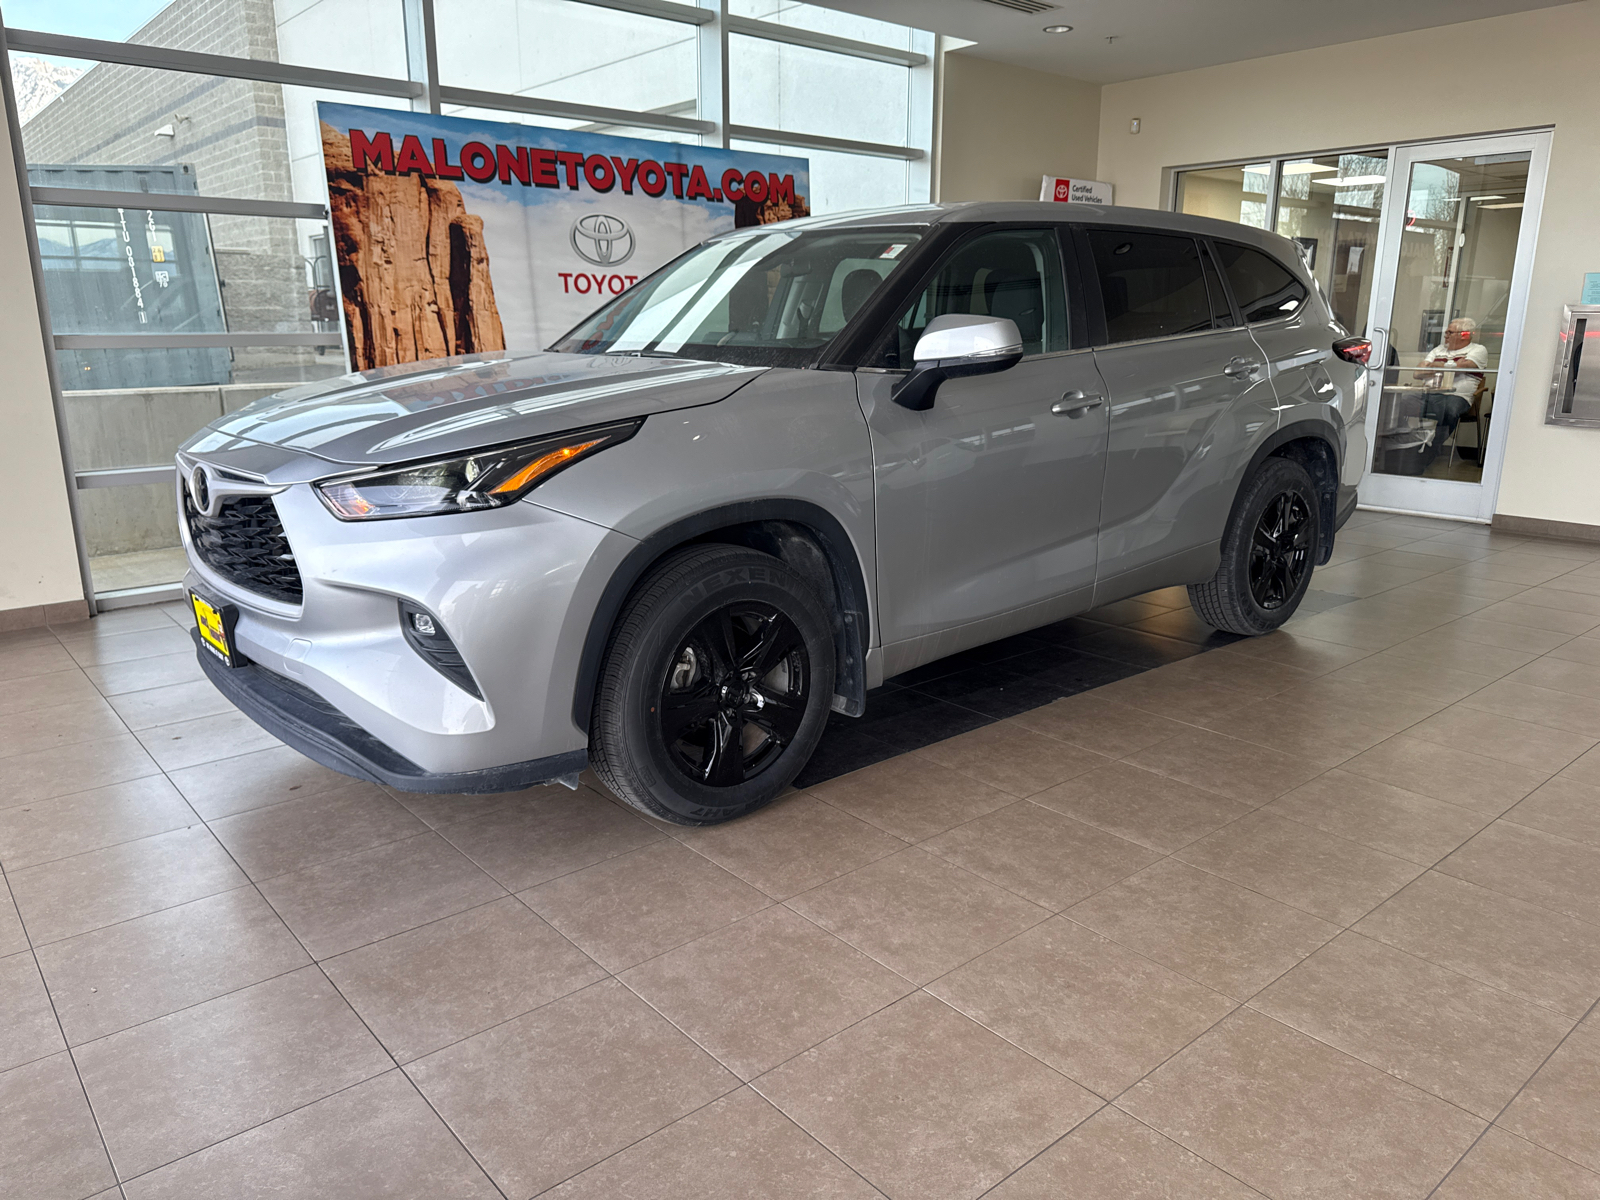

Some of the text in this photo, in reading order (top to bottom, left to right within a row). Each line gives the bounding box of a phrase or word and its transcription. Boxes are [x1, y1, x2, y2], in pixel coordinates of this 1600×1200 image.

[349, 129, 795, 205] MALONETOYOTA.COM
[1072, 184, 1093, 194] Certified
[1072, 194, 1103, 204] Used Vehicles
[118, 208, 130, 242] TTU
[558, 272, 638, 295] TOYOT
[680, 566, 786, 610] NEXEN
